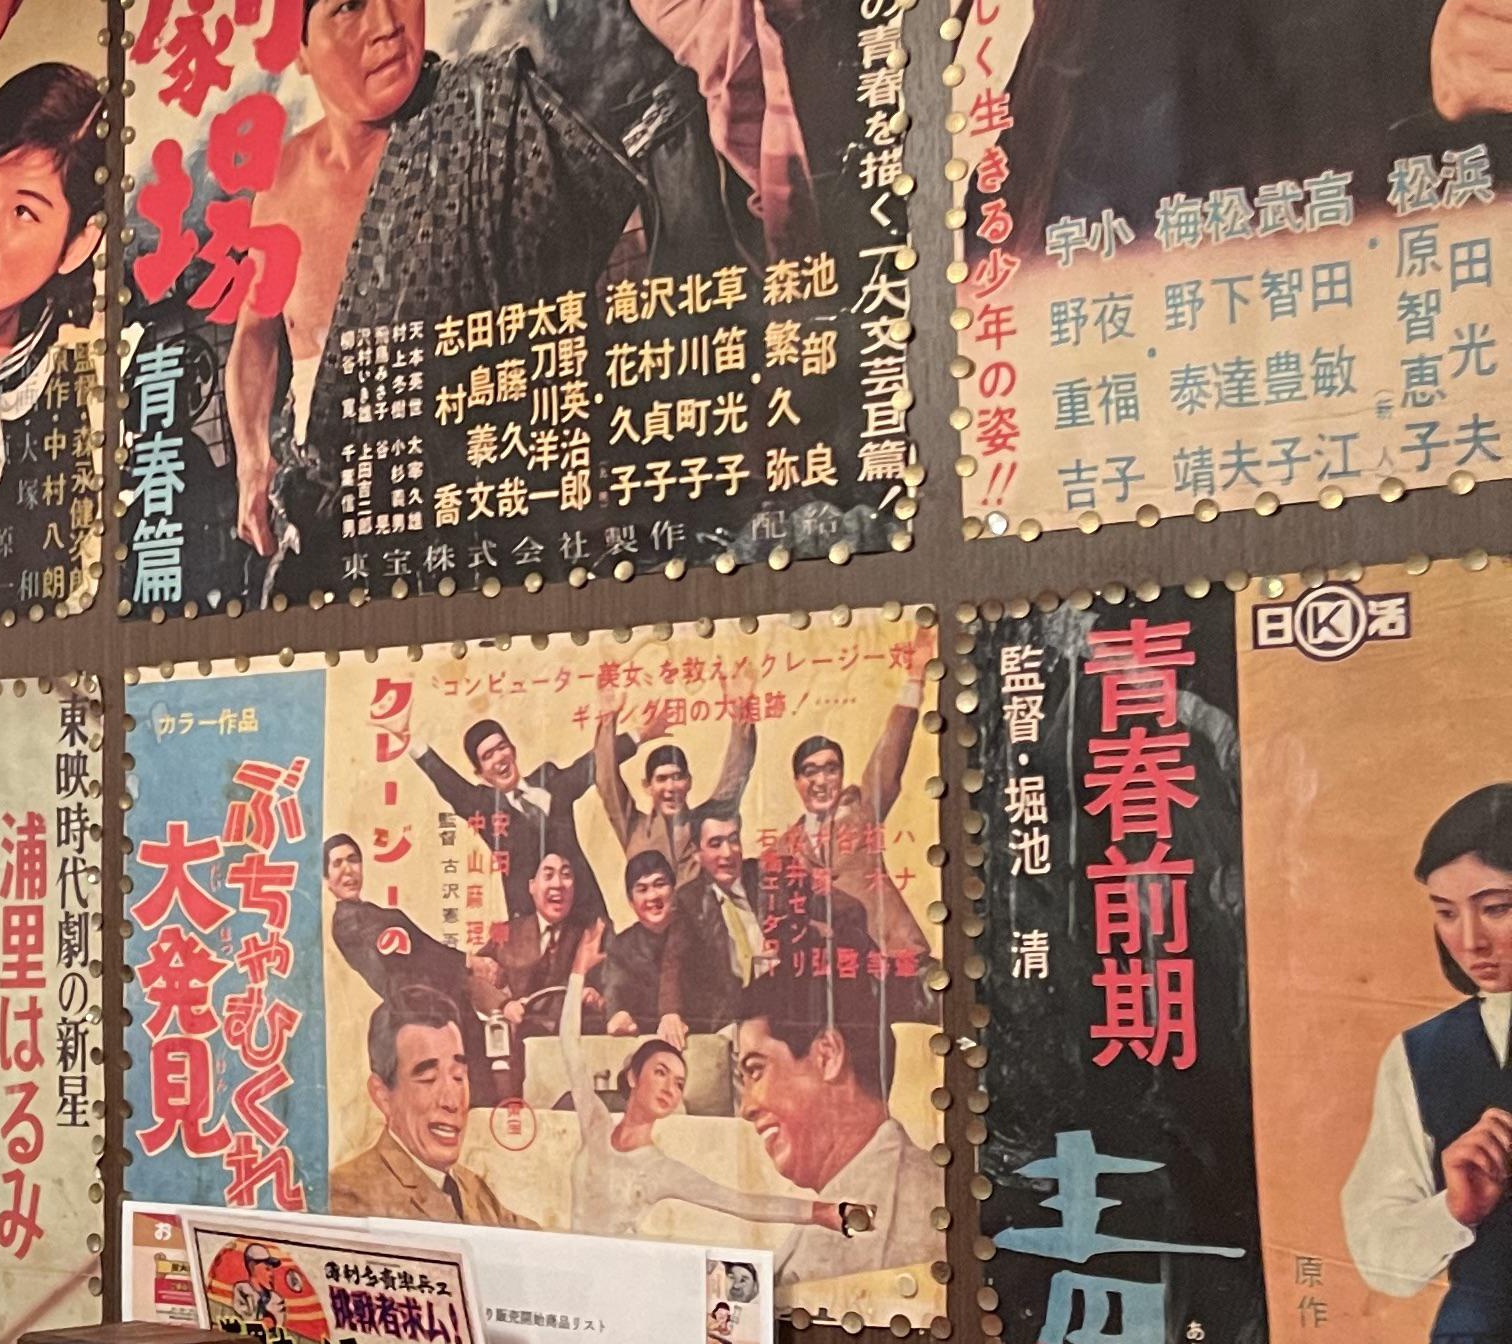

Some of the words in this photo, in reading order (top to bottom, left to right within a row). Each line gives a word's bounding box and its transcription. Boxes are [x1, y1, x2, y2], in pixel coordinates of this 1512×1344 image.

[408, 320, 425, 417] 天本英世
[433, 317, 465, 526] 志村喬
[466, 311, 497, 519] 田島義文
[497, 304, 529, 516] 伊藤久哉
[529, 301, 559, 509] 太刀川洋一
[556, 290, 593, 508] 東野英治郎
[605, 285, 642, 507] 滝花久子
[640, 278, 677, 503] 沢村貞子
[677, 275, 714, 500] 北川町子
[712, 265, 749, 498] 草笛光子
[761, 261, 802, 491] 森繁久弥
[799, 250, 839, 488] 池部良
[1045, 216, 1098, 510] 宇野重吉
[1089, 208, 1145, 504] 小夜福子
[1156, 196, 1215, 497] 梅野泰靖
[1206, 189, 1263, 490] 松下達夫
[1253, 180, 1311, 484] 武智豊子
[1303, 171, 1360, 479] 高田敏江
[1388, 155, 1450, 473] 松原智恵子
[1441, 144, 1500, 465] 浜田光夫
[41, 346, 69, 599] 原作・中村八朗
[131, 342, 186, 604] 青春篇
[157, 706, 260, 738] カラー作品
[369, 677, 415, 957] クレージーの
[438, 811, 458, 848] 監督
[1000, 645, 1051, 877] 監督・堀池
[54, 693, 91, 1129] 東映時代劇の新星
[893, 827, 920, 979] ハナ肇
[1009, 929, 1051, 980] 清
[1084, 618, 1200, 1071] 青春前期
[130, 821, 233, 1157] 大発見
[222, 757, 310, 1212] ぶちゃむくれ
